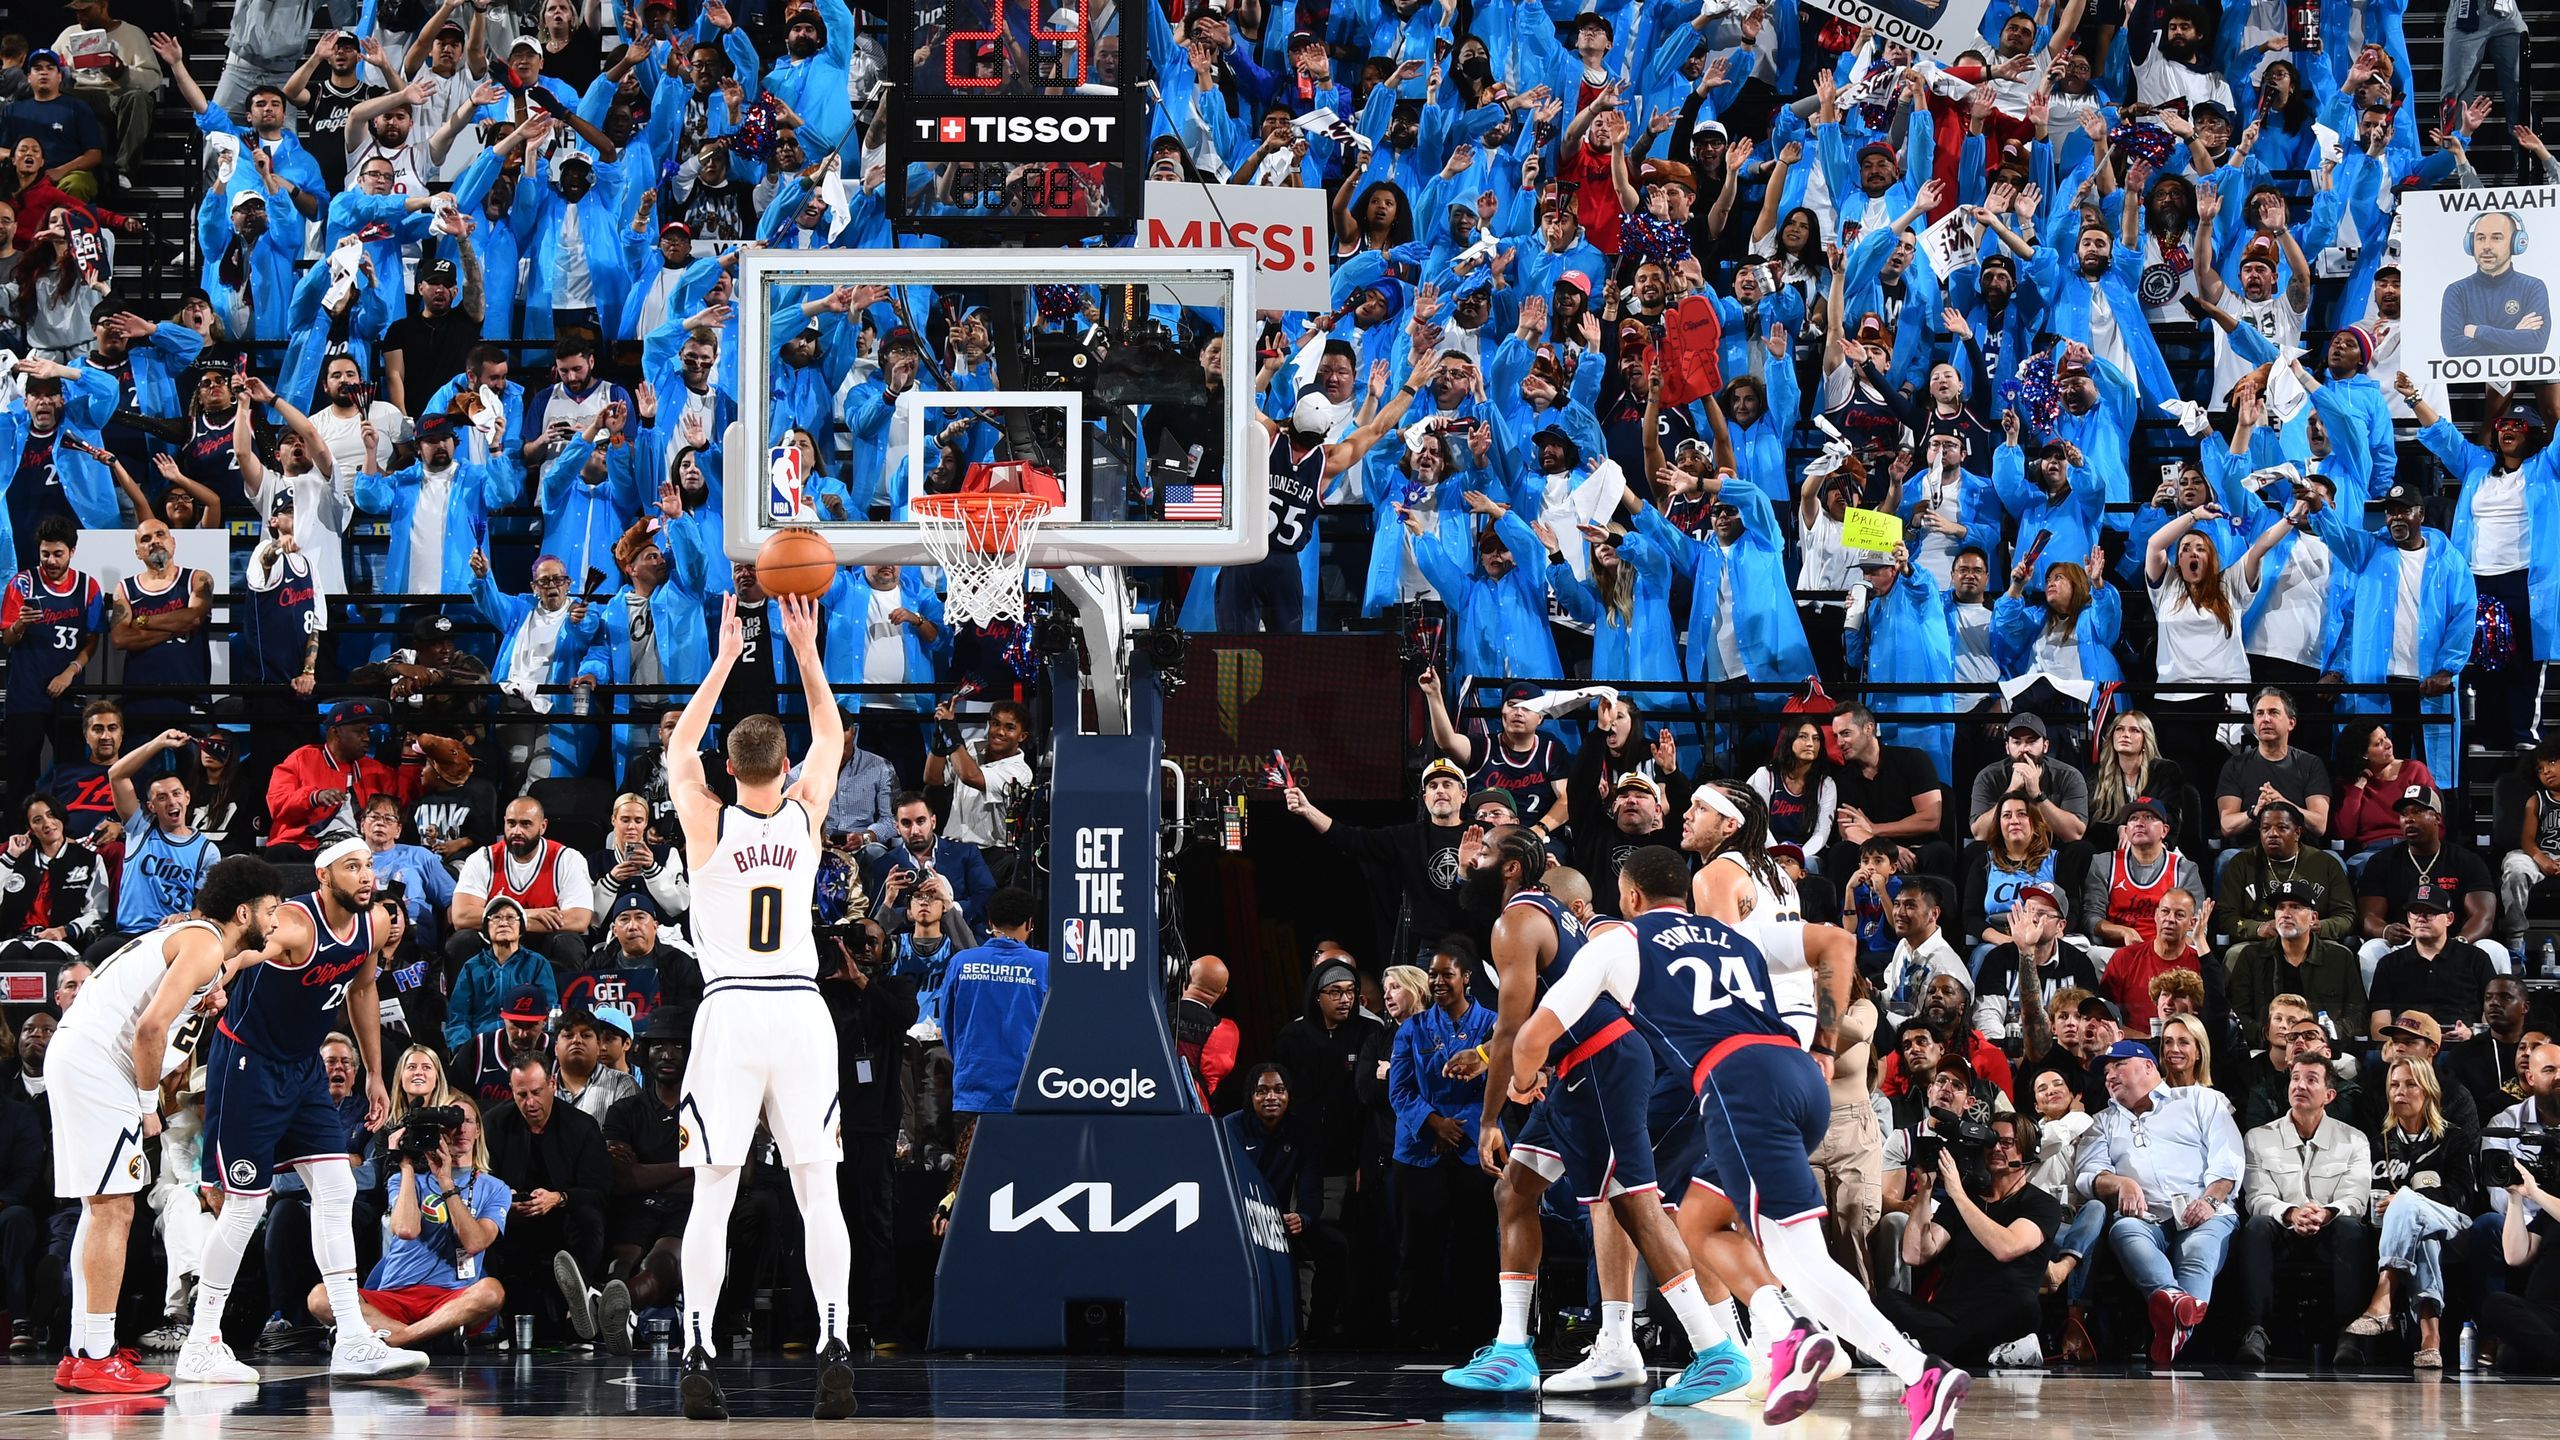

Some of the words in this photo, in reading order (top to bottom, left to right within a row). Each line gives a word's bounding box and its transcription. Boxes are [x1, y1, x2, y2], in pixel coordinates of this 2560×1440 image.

[1826, 0, 1872, 25] TOO
[1872, 11, 1943, 55] LOUD!
[315, 117, 347, 132] ange
[970, 117, 1116, 142] TISSOT
[2439, 193, 2556, 213] WAAAAH
[81, 232, 99, 263] GET
[1146, 216, 1316, 273] MISS!
[2427, 359, 2482, 380] TOO
[43, 463, 58, 486] 2
[1299, 486, 1313, 504] JR
[774, 502, 789, 516] NBA
[1851, 511, 1890, 530] BRICK
[53, 625, 79, 650] 33
[743, 641, 757, 662] 2
[1486, 770, 1545, 791] Clippers
[1527, 794, 1540, 813] 2
[733, 844, 798, 874] BRAUN
[1075, 828, 1124, 869] GET
[137, 853, 192, 885] Clips
[158, 883, 191, 911] 33
[1075, 873, 1124, 914] THE
[2282, 882, 2292, 893] B
[748, 886, 783, 954] 0
[1087, 921, 1136, 964] App
[1652, 924, 1733, 951] POWELL
[301, 951, 369, 987] Clippers
[963, 961, 1034, 977] SECURITY
[992, 973, 1014, 984] LIVES
[1015, 976, 1037, 986] HERE
[594, 982, 626, 1001] GET
[1666, 956, 1765, 1016] 24
[1037, 1066, 1157, 1108] Google
[989, 1182, 1200, 1233] KIA
[1244, 1181, 1289, 1253] coinbase
[344, 1344, 388, 1362] AIR
